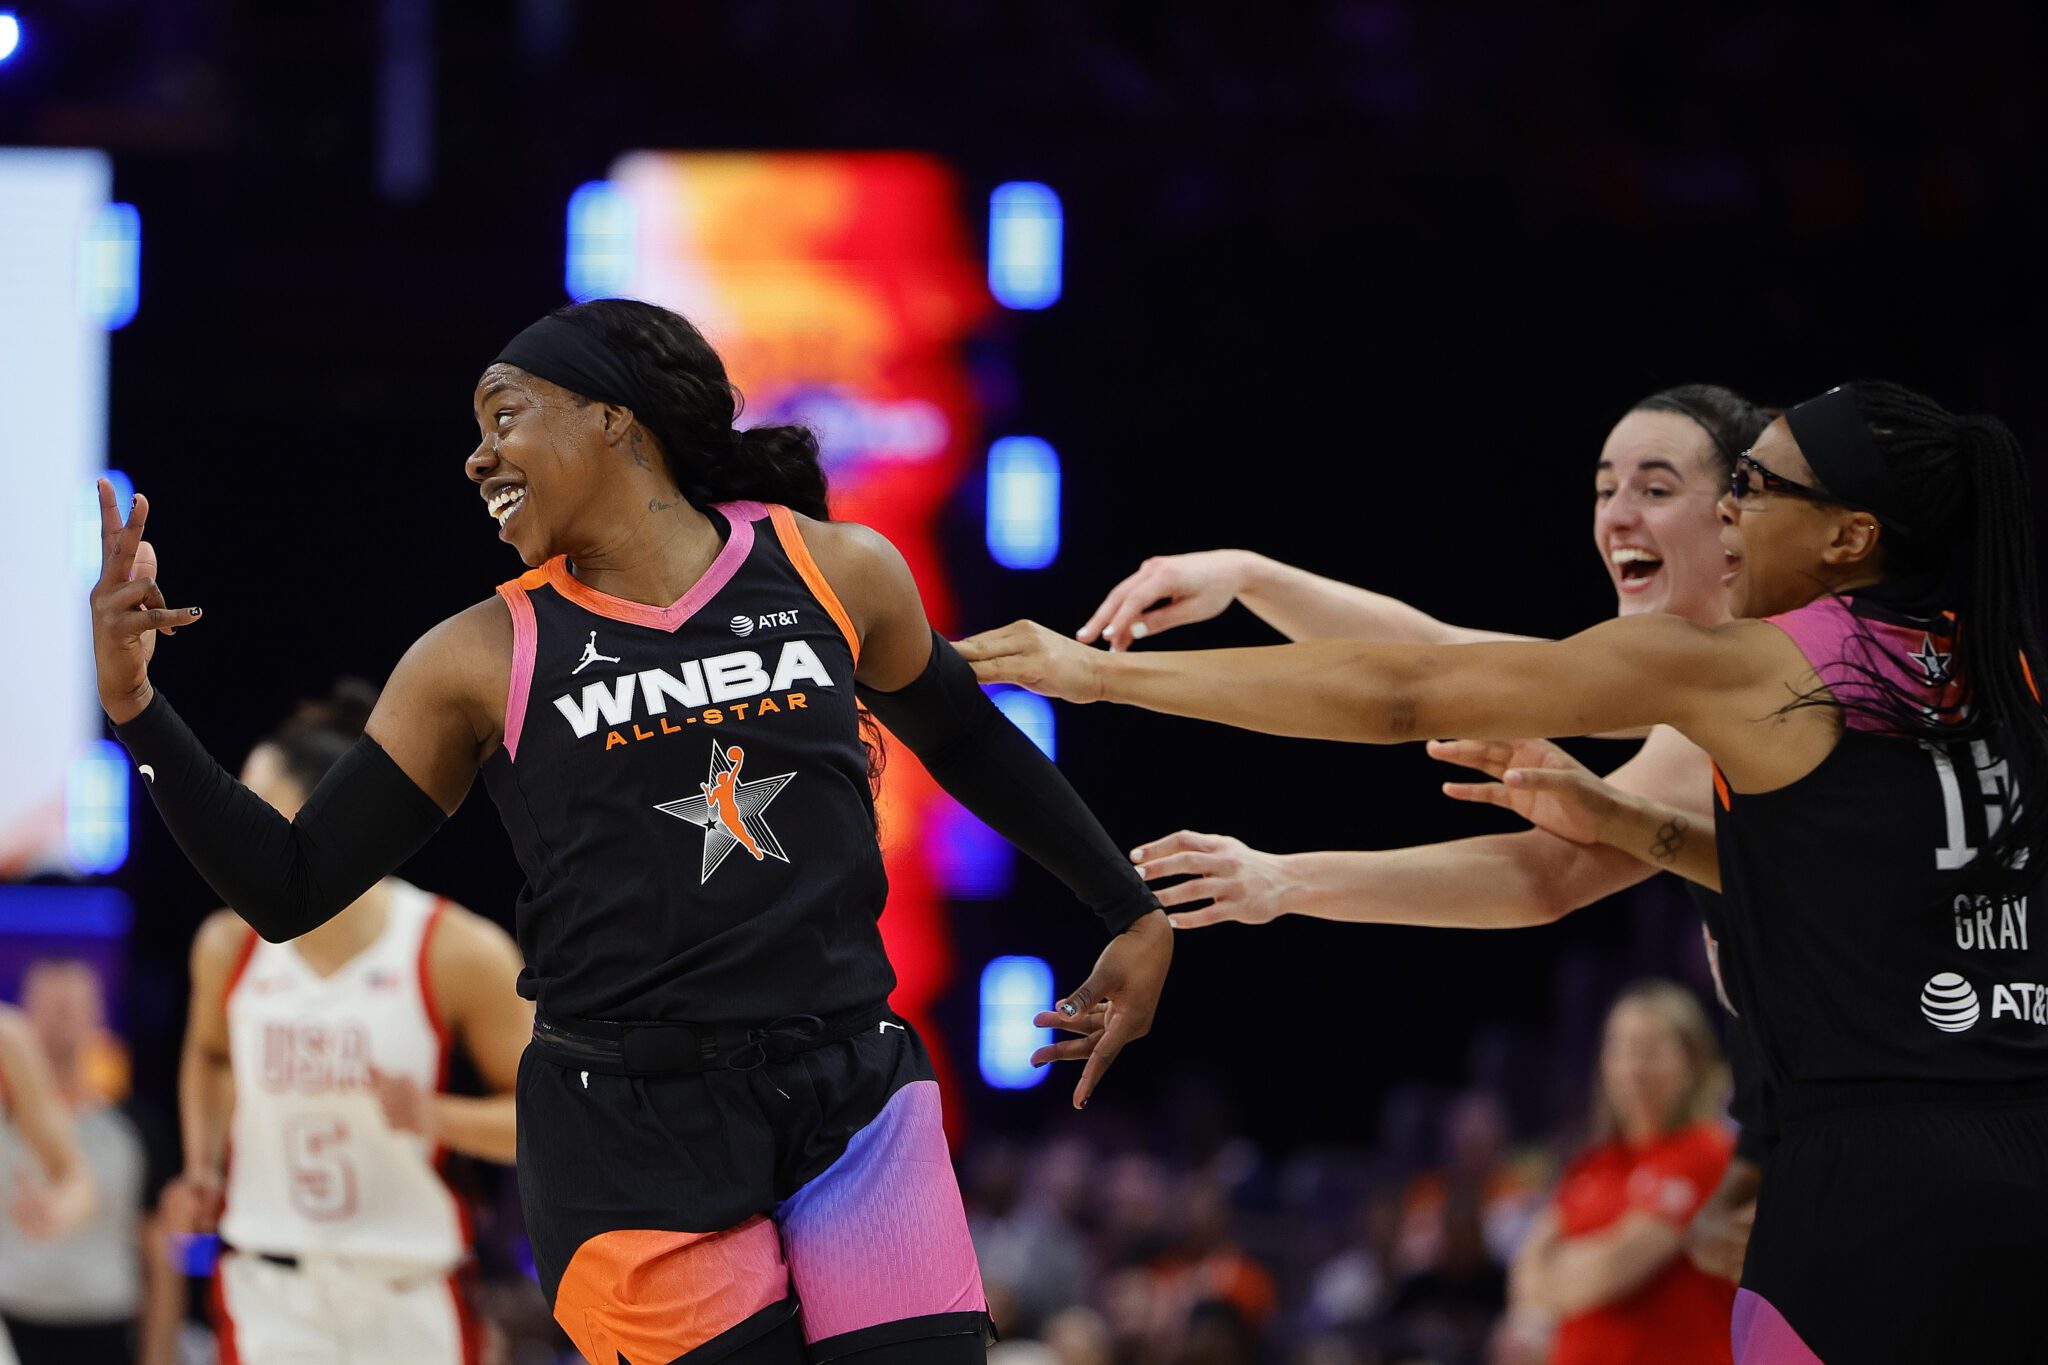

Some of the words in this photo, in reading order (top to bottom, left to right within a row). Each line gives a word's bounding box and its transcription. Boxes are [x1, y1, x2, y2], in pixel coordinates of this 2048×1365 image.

[758, 609, 799, 630] AT&T
[553, 640, 835, 739] WNBA
[605, 692, 809, 751] ALL-STAR
[1954, 894, 2028, 950] GRAY
[1992, 982, 2048, 1026] AT&
[284, 1113, 359, 1222] 5
